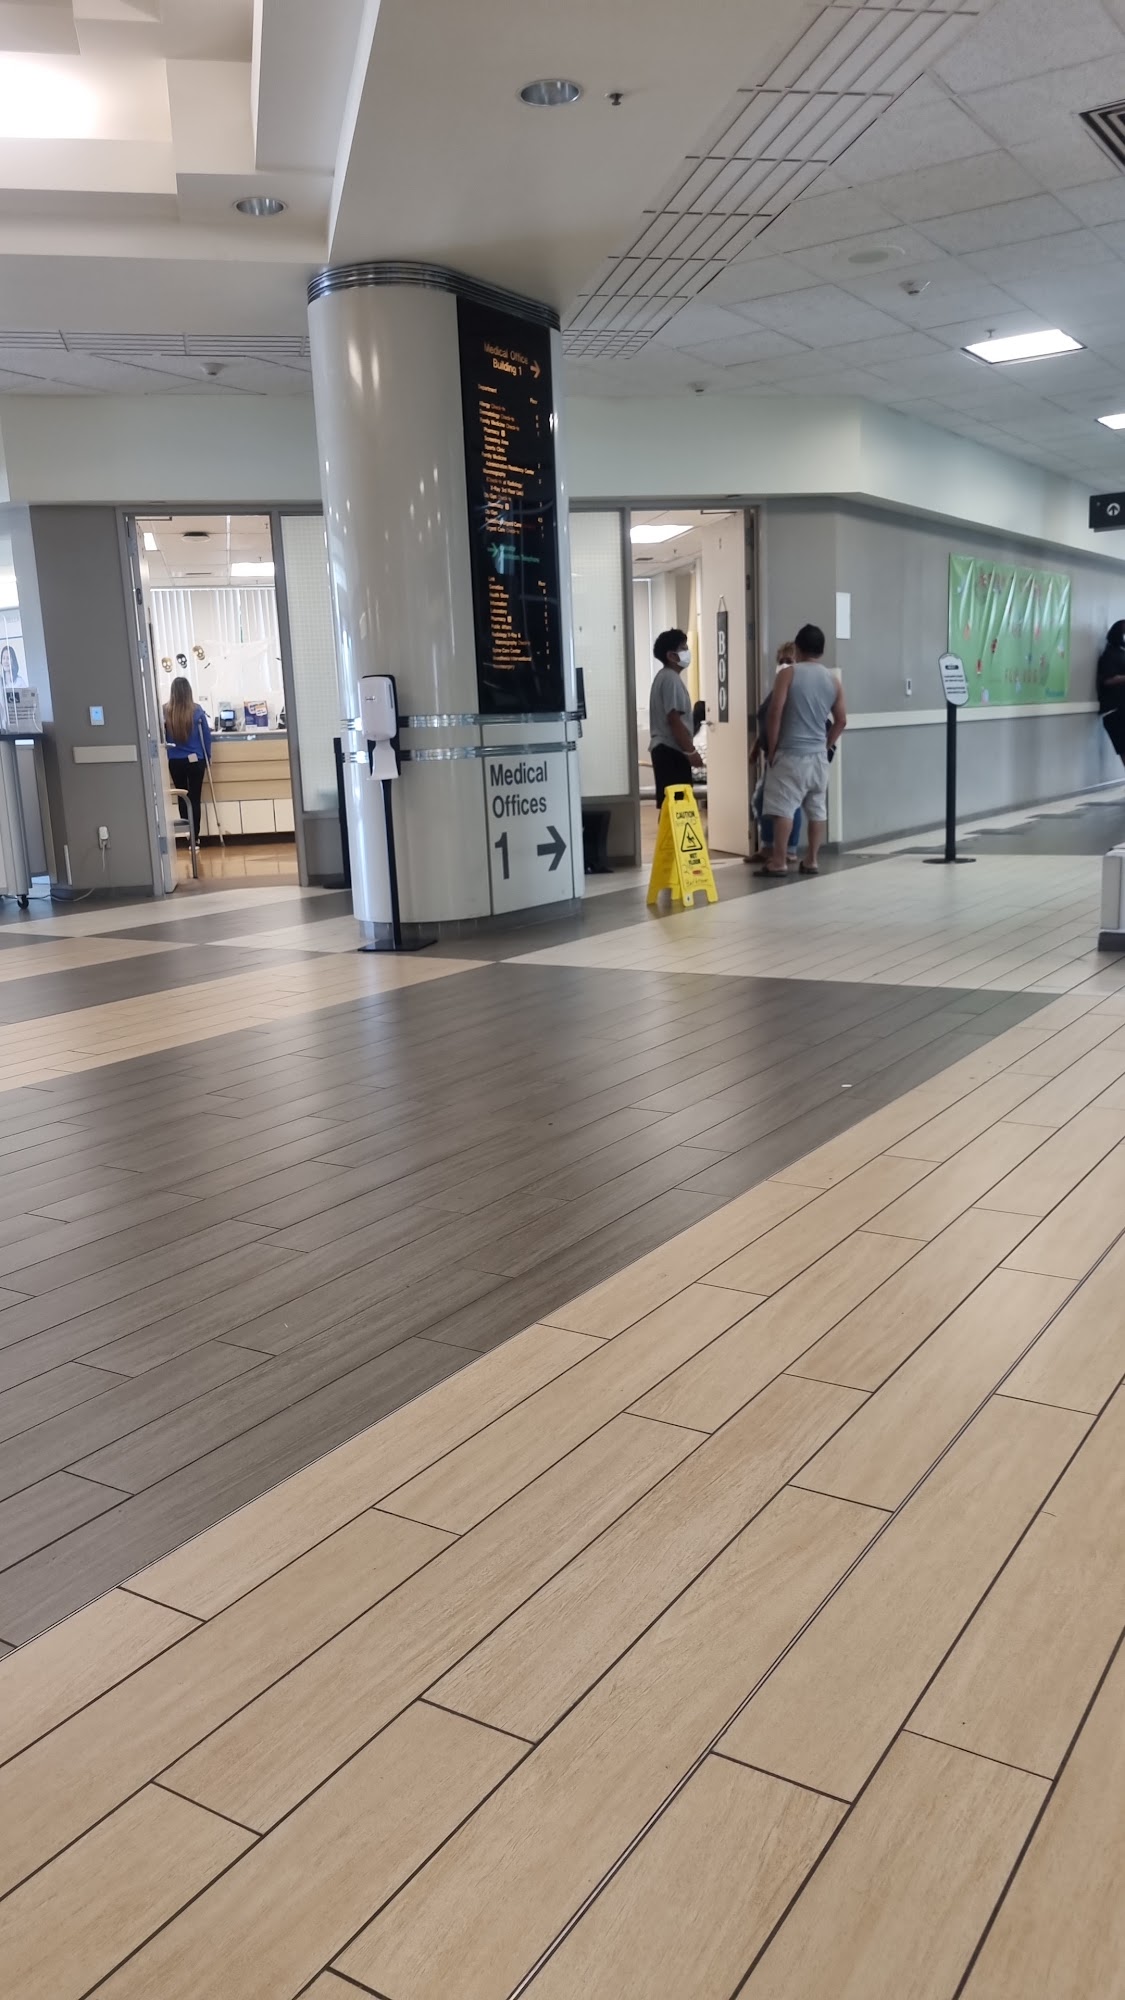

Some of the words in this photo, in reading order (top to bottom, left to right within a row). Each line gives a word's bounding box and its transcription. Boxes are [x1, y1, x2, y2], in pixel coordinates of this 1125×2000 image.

[484, 341, 508, 358] Medical
[510, 351, 528, 365] Office
[493, 358, 517, 376] Building
[518, 366, 522, 376] 1
[718, 631, 726, 710] BOO
[490, 761, 547, 786] Medical
[492, 794, 547, 818] Offices
[676, 811, 695, 819] CAUTION
[495, 832, 510, 880] 1
